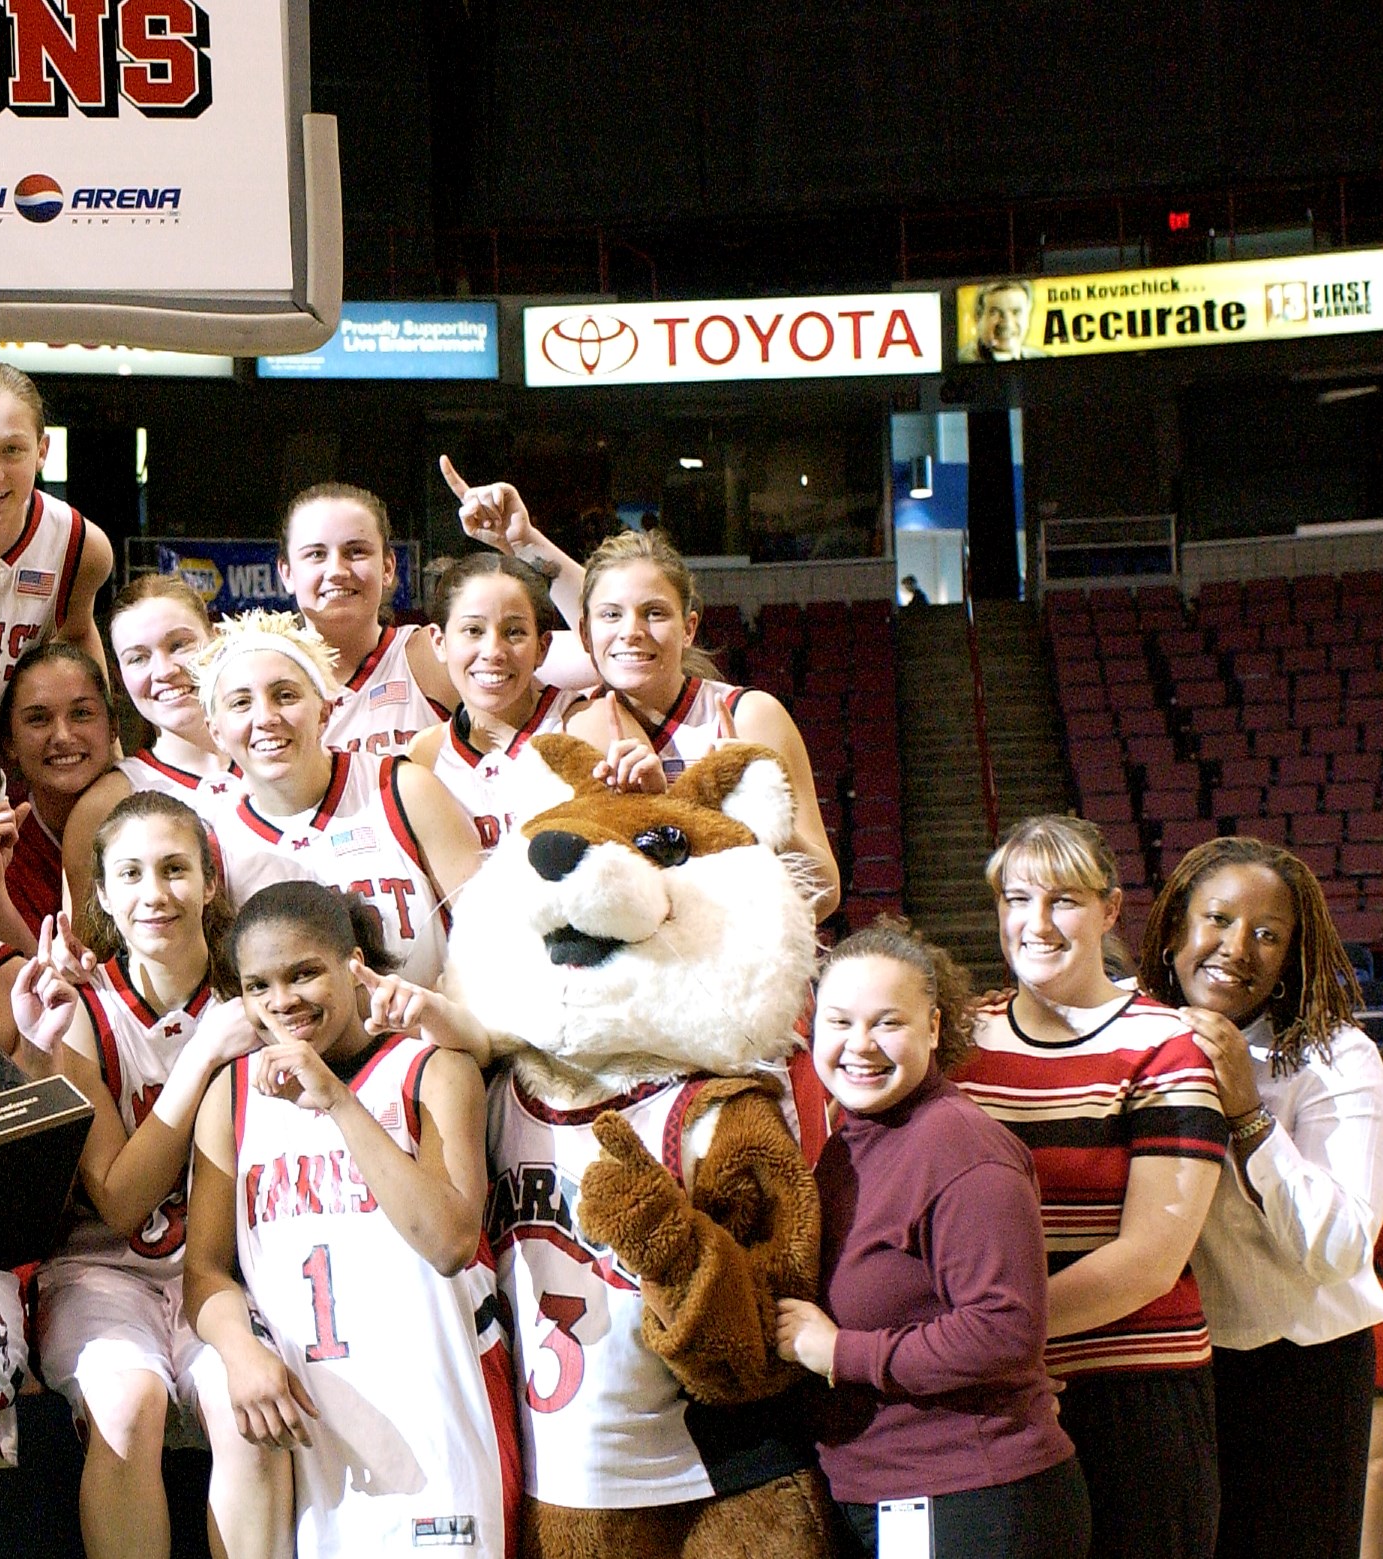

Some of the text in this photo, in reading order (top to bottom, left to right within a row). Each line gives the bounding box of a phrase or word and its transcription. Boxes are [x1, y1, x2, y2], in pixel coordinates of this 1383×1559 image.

[71, 188, 182, 209] ARENA
[1047, 285, 1082, 304] Bob
[1313, 280, 1371, 304] FIRST
[340, 320, 488, 340] Proudly Supporting
[1043, 298, 1247, 346] Accurate
[343, 336, 486, 352] Live Entertainment
[653, 308, 924, 367] TOYOTA
[228, 564, 295, 600] WEL
[302, 1244, 350, 1363] 1
[525, 1290, 587, 1413] 3
